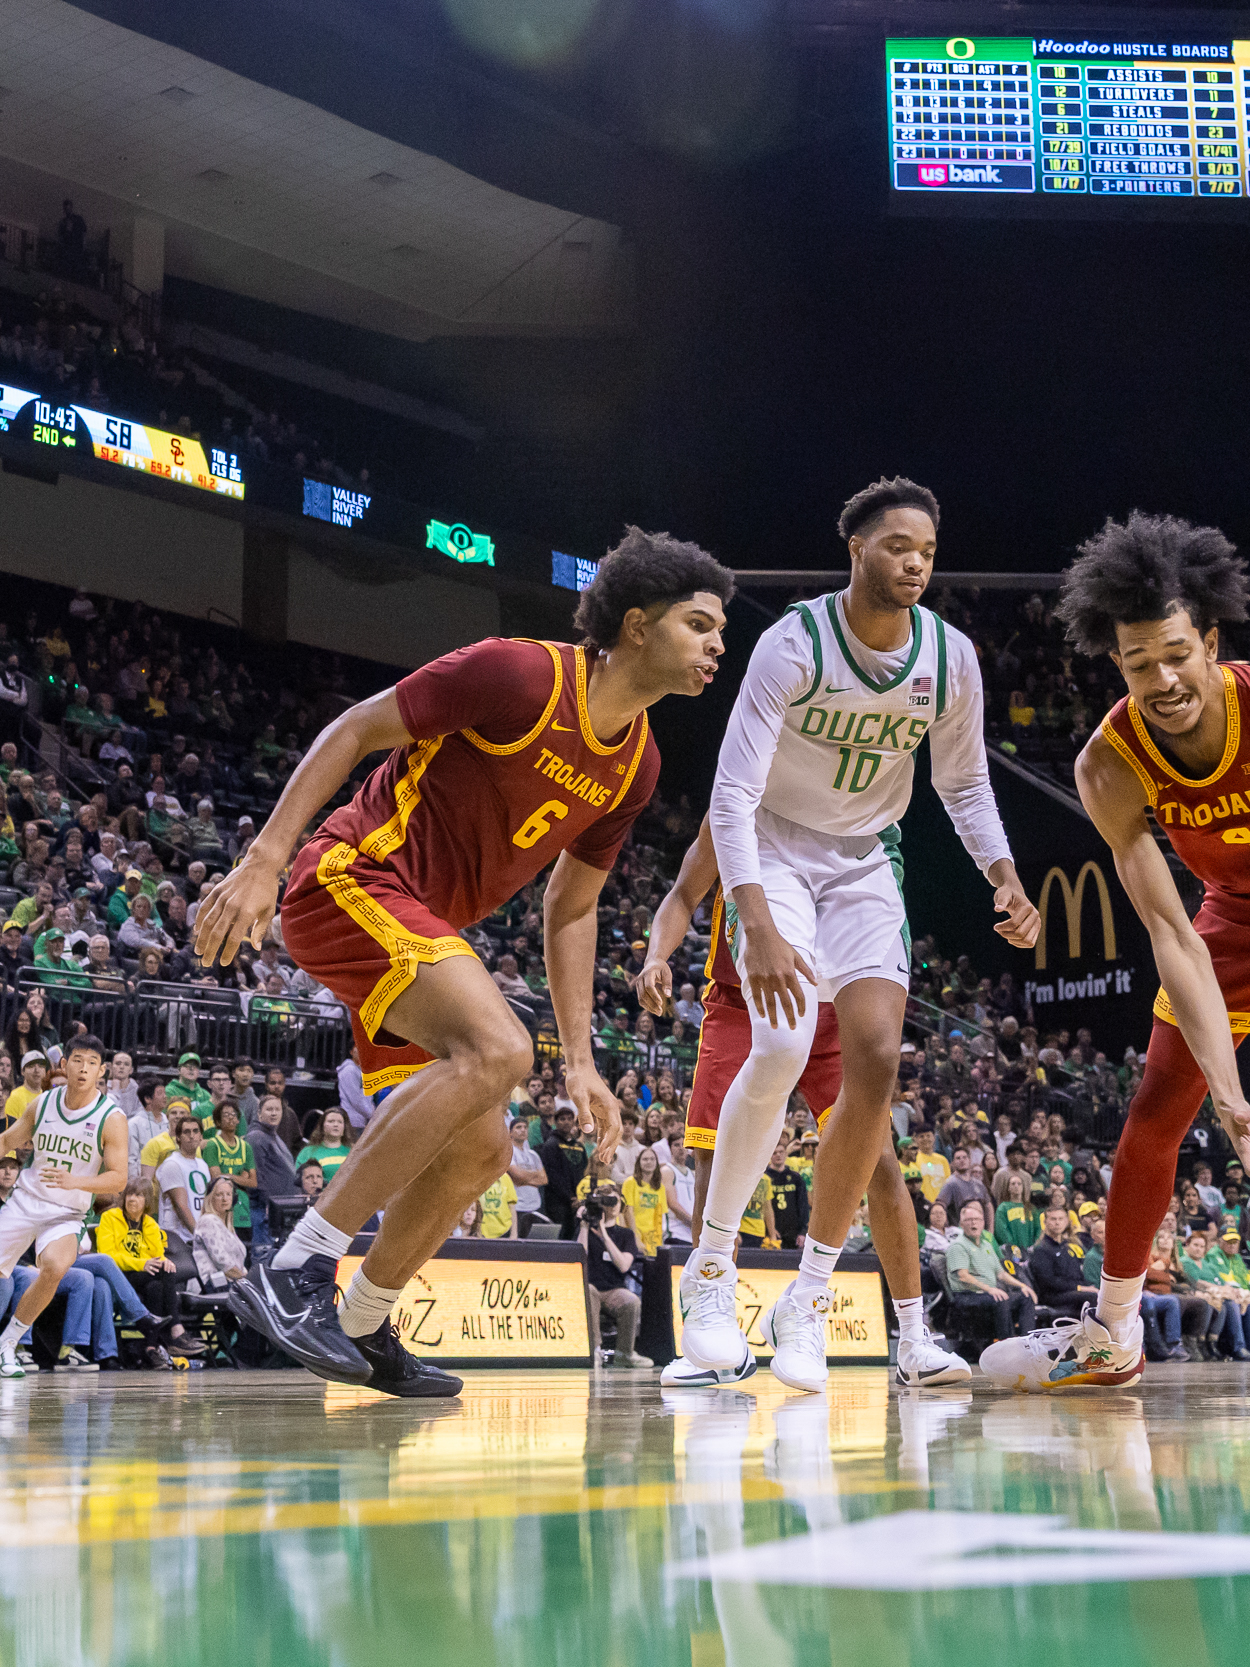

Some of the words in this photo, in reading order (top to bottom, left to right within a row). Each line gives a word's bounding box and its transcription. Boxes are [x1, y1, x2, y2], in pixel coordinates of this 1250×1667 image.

[946, 38, 975, 59] O
[1038, 40, 1110, 54] Hoodoo
[1113, 44, 1167, 56] HUSTLE
[1172, 45, 1228, 58] BOARDS
[927, 64, 943, 73] PTS
[978, 65, 995, 74] AST
[1012, 66, 1018, 74] F
[1054, 67, 1065, 78] 10
[1107, 70, 1163, 82] ASSISTS
[1206, 72, 1218, 83] 10
[904, 81, 910, 89] 3
[930, 80, 939, 90] 11
[959, 80, 964, 90] 1
[983, 81, 992, 91] 4
[1014, 81, 1019, 92] 1
[1055, 86, 1066, 97] 12
[1098, 88, 1174, 100] TURNOVERS
[1209, 91, 1218, 101] 11
[902, 97, 913, 106] 10
[929, 97, 941, 107] 13
[958, 98, 965, 108] 6
[985, 98, 992, 108] 2
[1015, 99, 1020, 109] 1
[1057, 104, 1065, 115] 6
[1113, 106, 1162, 118] STEALS
[1210, 107, 1218, 118] 7
[903, 114, 914, 123] 13
[960, 114, 965, 123] 1
[1015, 115, 1022, 125] 3
[1056, 122, 1069, 134] 21
[1104, 125, 1172, 137] REBOUNDS
[1208, 127, 1223, 138] 23
[901, 131, 915, 139] 22
[932, 131, 940, 140] 3
[961, 131, 965, 141] 1
[988, 132, 993, 141] 1
[1017, 132, 1021, 142] 1
[902, 149, 917, 158] 23
[934, 149, 939, 158] 1
[1049, 141, 1081, 153] 17/39
[1097, 143, 1133, 154] FIELD
[1139, 144, 1181, 155] GOALS
[1203, 145, 1232, 157] 21/41
[1049, 159, 1079, 171] 10/13
[1096, 161, 1130, 172] FREE
[1134, 162, 1185, 174] THROWS
[1208, 163, 1234, 175] 9/13
[921, 167, 945, 182] us
[1102, 180, 1181, 193] 3-POINTERS
[34, 400, 76, 431] 10:43
[34, 424, 58, 446] 2ND
[106, 418, 132, 450] 58
[230, 454, 237, 467] 3
[150, 460, 170, 478] 69.2
[198, 474, 216, 490] 41.2
[212, 462, 226, 477] FLS
[332, 486, 371, 509] VALLEY
[332, 500, 363, 519] RIVER
[332, 512, 352, 528] INN
[576, 557, 600, 575] VALL
[801, 706, 928, 750] DUCKS
[832, 746, 882, 793] 10
[534, 748, 612, 807] TROJANS
[512, 800, 569, 849] 6
[1058, 972, 1112, 1000] lovin'
[1115, 969, 1131, 994] it
[38, 1133, 92, 1163] DUCKS
[188, 1170, 208, 1195] O
[481, 1279, 531, 1310] 100%
[534, 1288, 550, 1309] for
[410, 1299, 442, 1346] Z
[462, 1316, 485, 1339] ALL
[489, 1316, 513, 1339] THE
[518, 1316, 565, 1340] THINGS
[828, 1320, 867, 1340] THINGS
